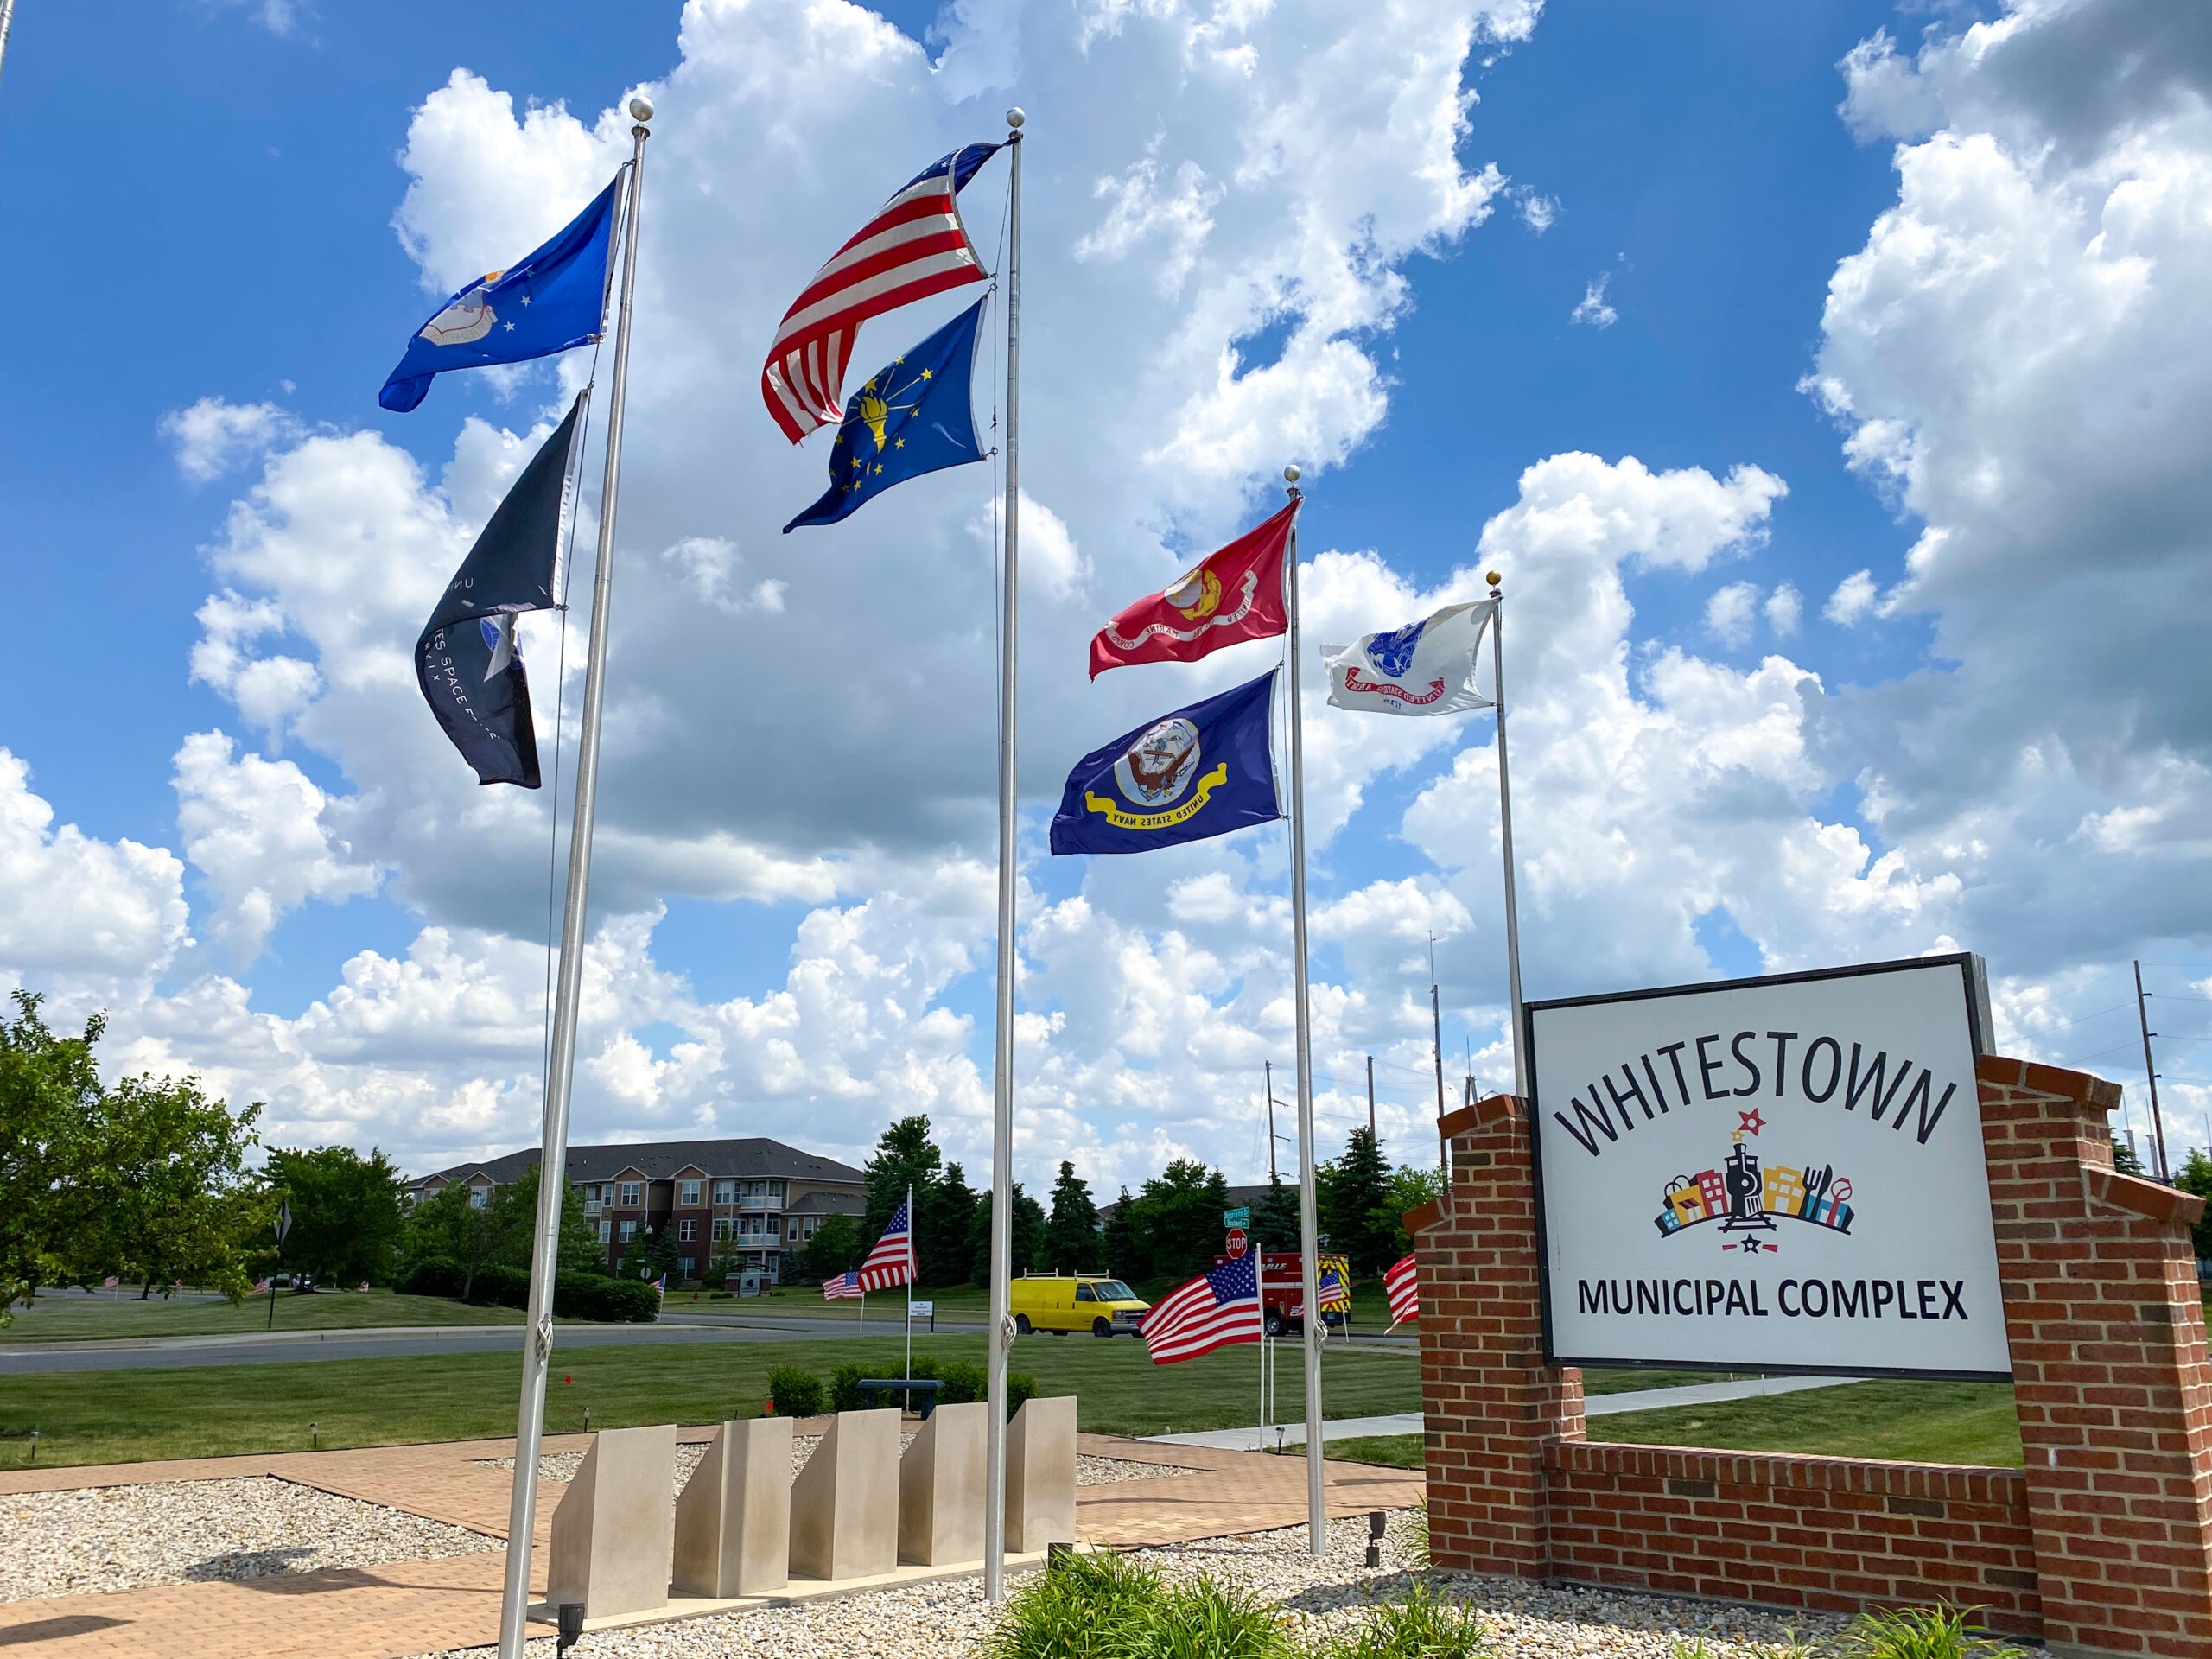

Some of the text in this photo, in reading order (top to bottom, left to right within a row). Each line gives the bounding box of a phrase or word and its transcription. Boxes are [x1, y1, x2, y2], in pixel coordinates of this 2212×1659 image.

[441, 656, 468, 705] SPACE
[1553, 1031, 1957, 1156] WHITESTOWN
[1227, 1237, 1246, 1250] STOP
[1262, 1262, 1287, 1272] VILLE
[1579, 1278, 1968, 1320] MUNICIPAL COMPLEX
